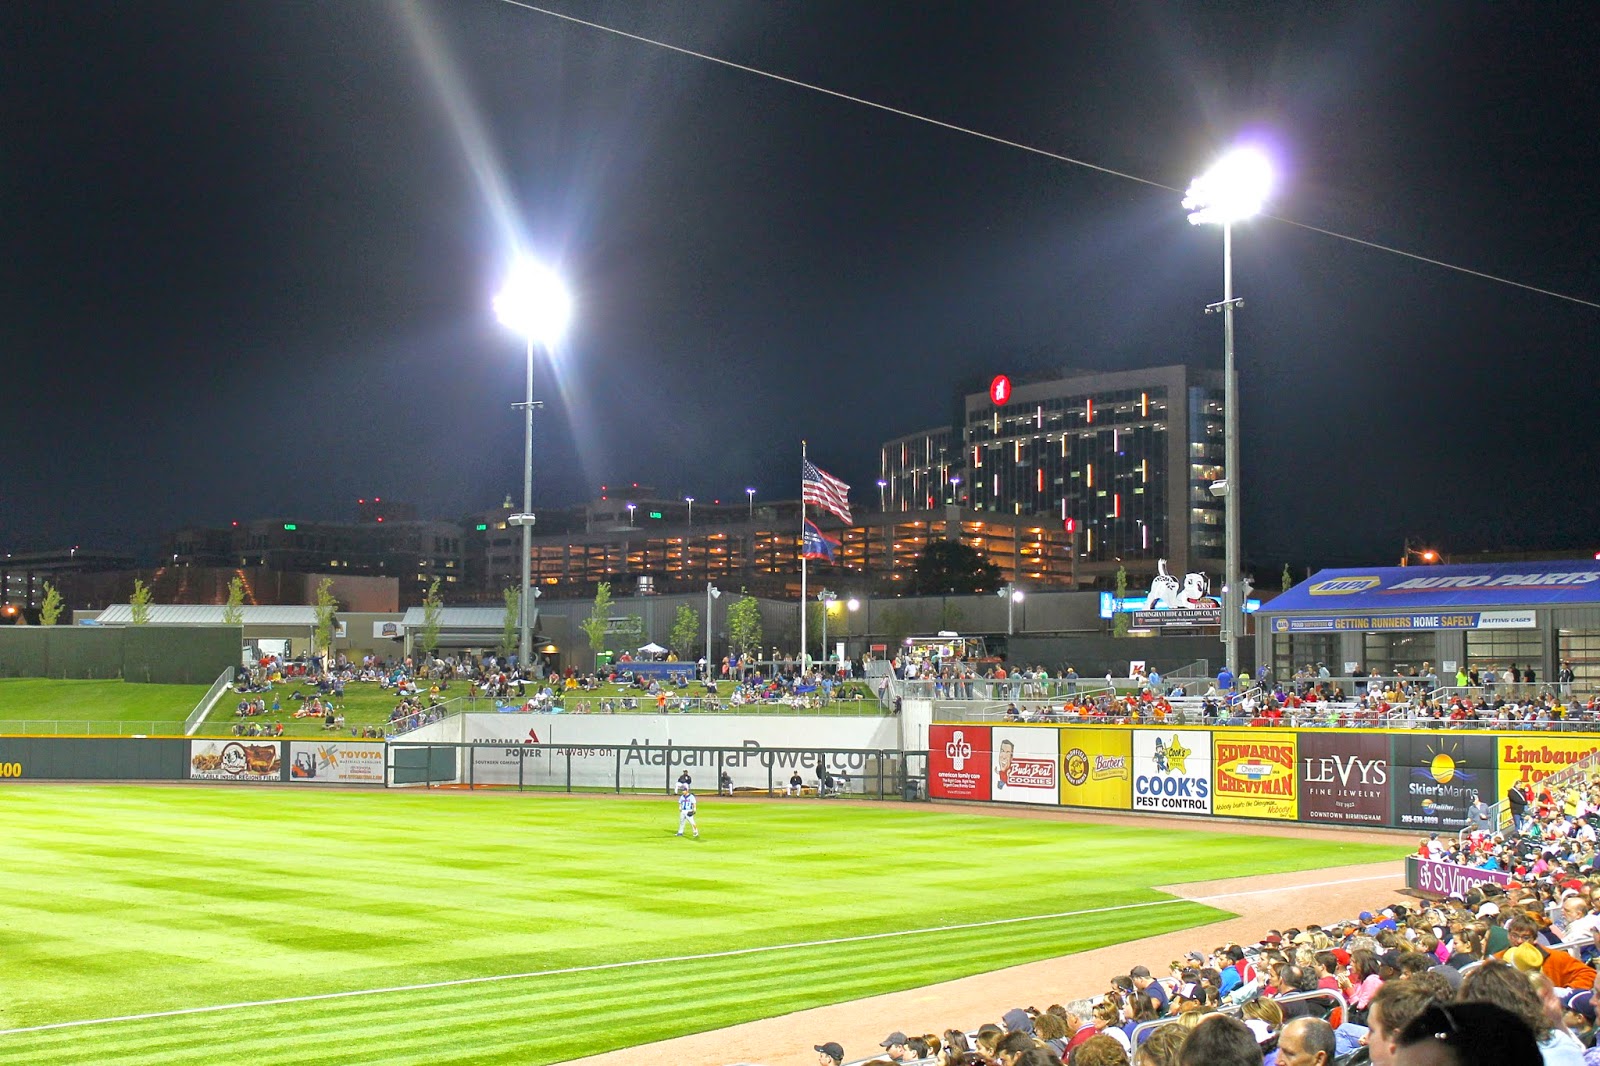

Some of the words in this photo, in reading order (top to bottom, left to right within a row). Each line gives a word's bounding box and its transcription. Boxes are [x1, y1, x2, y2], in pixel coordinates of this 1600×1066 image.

[1315, 579, 1374, 592] NAPA
[1387, 575, 1486, 590] AUTO
[1490, 571, 1600, 586] PARTS
[1135, 610, 1166, 618] BIRMINGHAM
[1335, 617, 1369, 629] GETTING
[1371, 616, 1411, 628] RUNNERS
[1413, 616, 1439, 628] HOME
[1441, 616, 1475, 627] SAFELY.
[505, 748, 542, 758] POWER
[947, 738, 970, 758] afc
[340, 750, 382, 759] TOYOTA
[1217, 744, 1293, 769] EDWARDS
[1009, 764, 1031, 776] Bud's
[1030, 764, 1053, 776] Best
[1241, 765, 1265, 773] Chevrolet
[1304, 754, 1387, 787] LEVYS
[957, 772, 971, 780] family
[1009, 777, 1053, 785] COOKIES
[1136, 775, 1208, 798] COOK'S
[1217, 768, 1293, 797] CHEVYMAN
[1309, 788, 1332, 796] FINE
[1338, 789, 1381, 798] JEWELRY
[1136, 796, 1160, 807] PEST
[1162, 799, 1208, 810] CONTROL
[1267, 806, 1293, 814] Nobody!
[1310, 811, 1343, 819] DOWNTOWN
[1345, 813, 1382, 821] BIRMINGHAM
